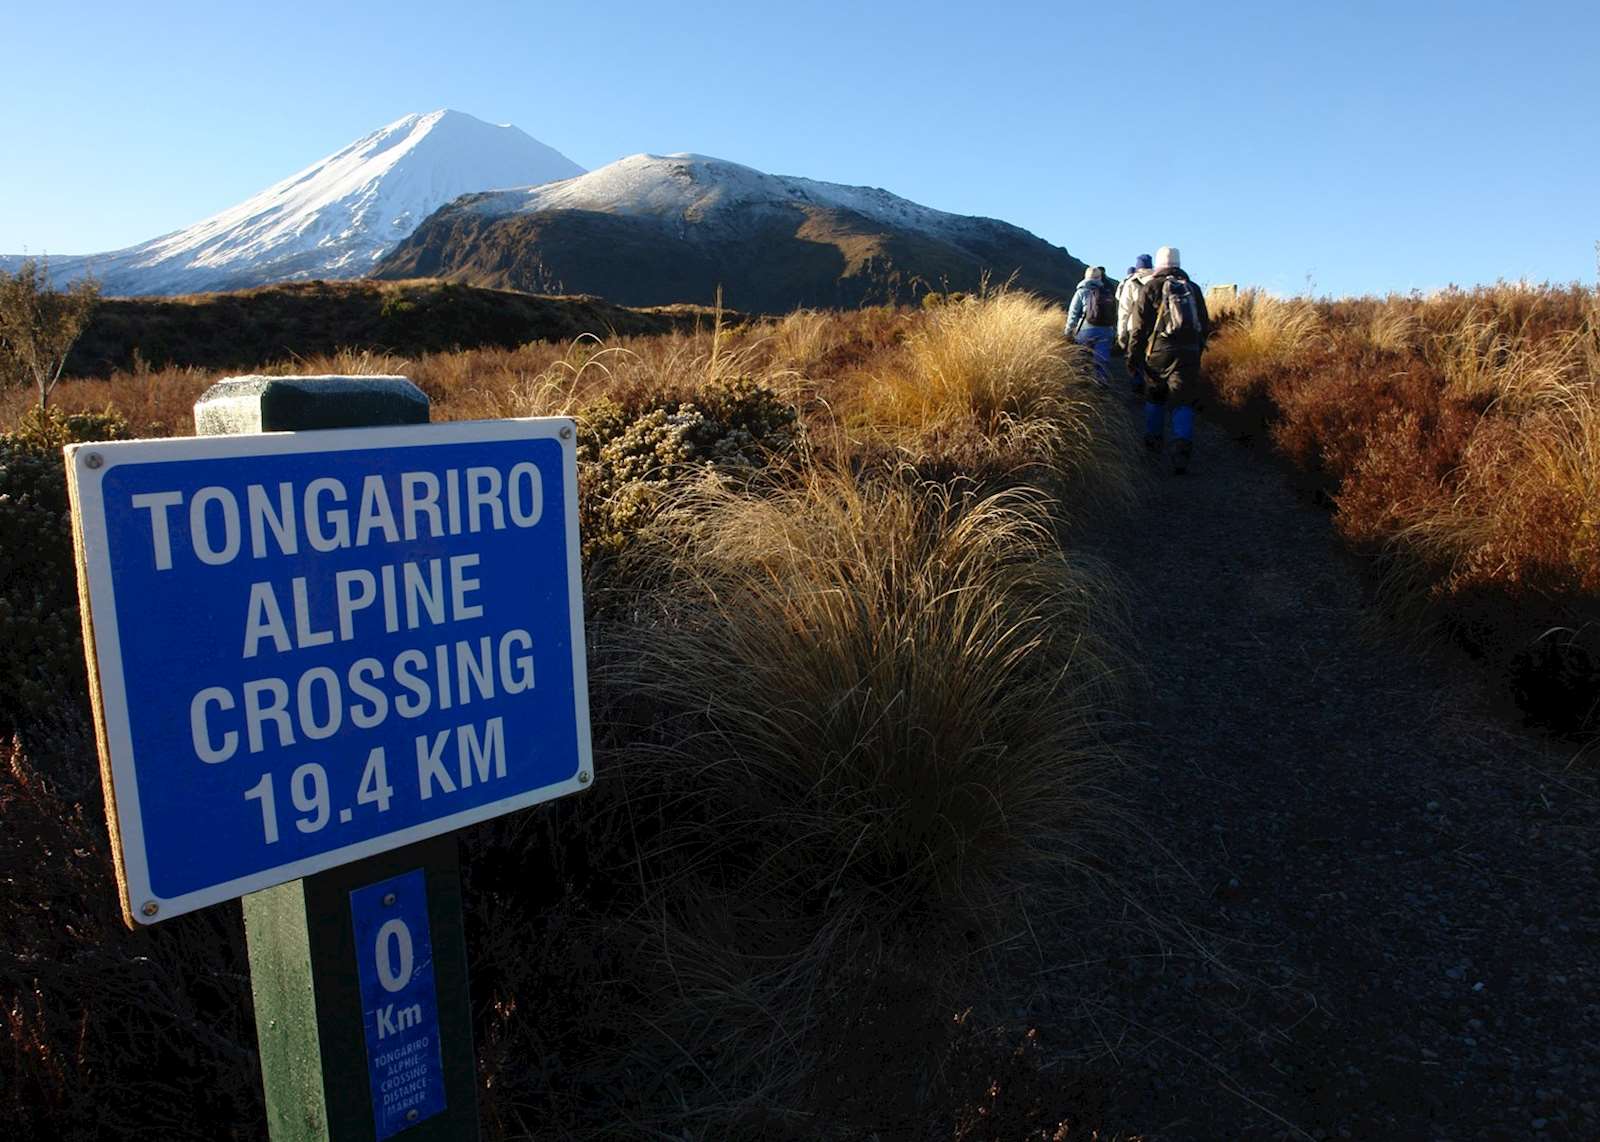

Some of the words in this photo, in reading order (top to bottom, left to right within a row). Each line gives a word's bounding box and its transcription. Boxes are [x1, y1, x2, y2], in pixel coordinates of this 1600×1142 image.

[131, 461, 544, 572] TONGARIRO
[242, 552, 484, 659] ALPINE
[189, 628, 536, 764] CROSSING
[244, 746, 394, 845] 19.4
[416, 716, 507, 800] KM
[375, 918, 414, 992] 0
[374, 1036, 429, 1068] TONGARIRO
[376, 1003, 422, 1040] Km
[381, 1064, 428, 1092] CROSSING
[383, 1077, 427, 1105] DISTANCE
